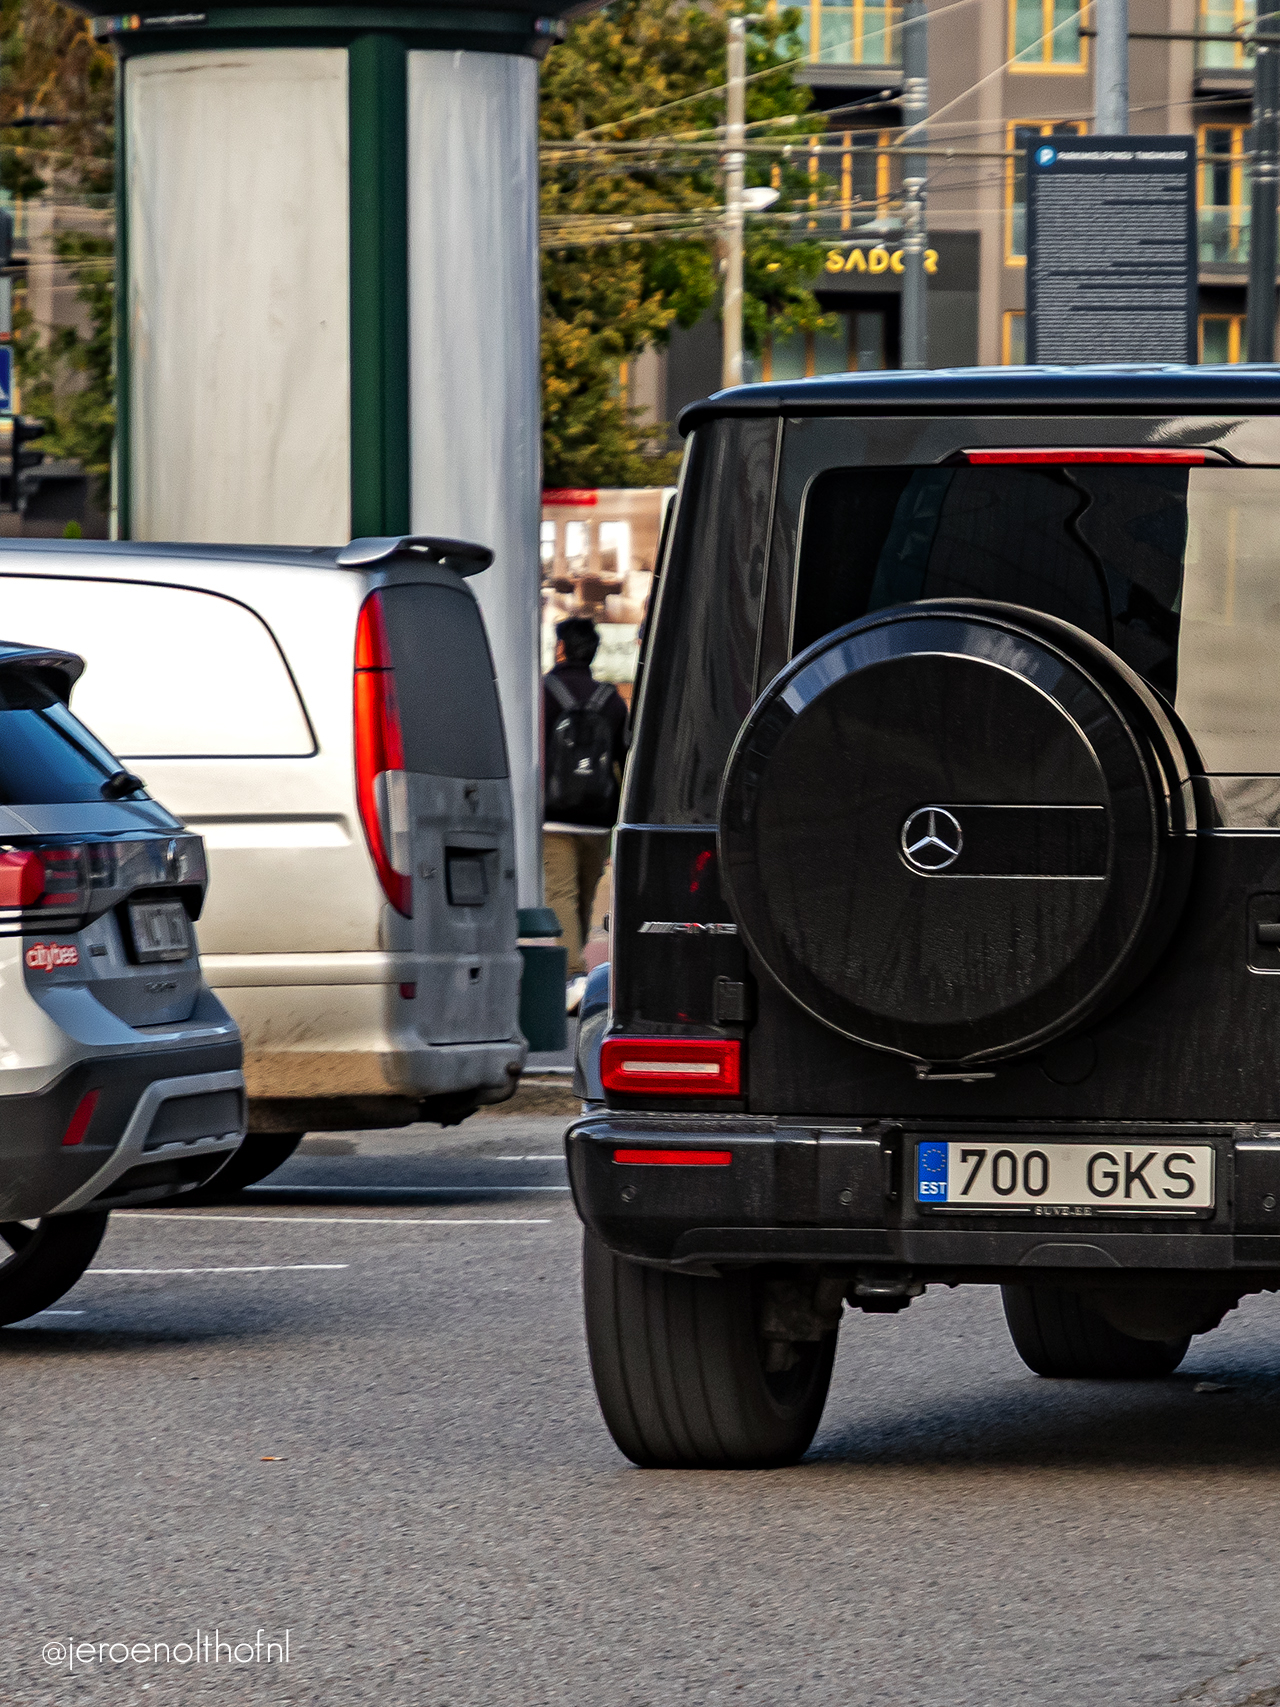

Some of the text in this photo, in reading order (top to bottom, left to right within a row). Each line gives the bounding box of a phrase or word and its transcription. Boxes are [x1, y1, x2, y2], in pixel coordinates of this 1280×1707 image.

[26, 942, 80, 973] citybee
[919, 1181, 947, 1195] EST
[959, 1147, 1196, 1200] 700 GKS
